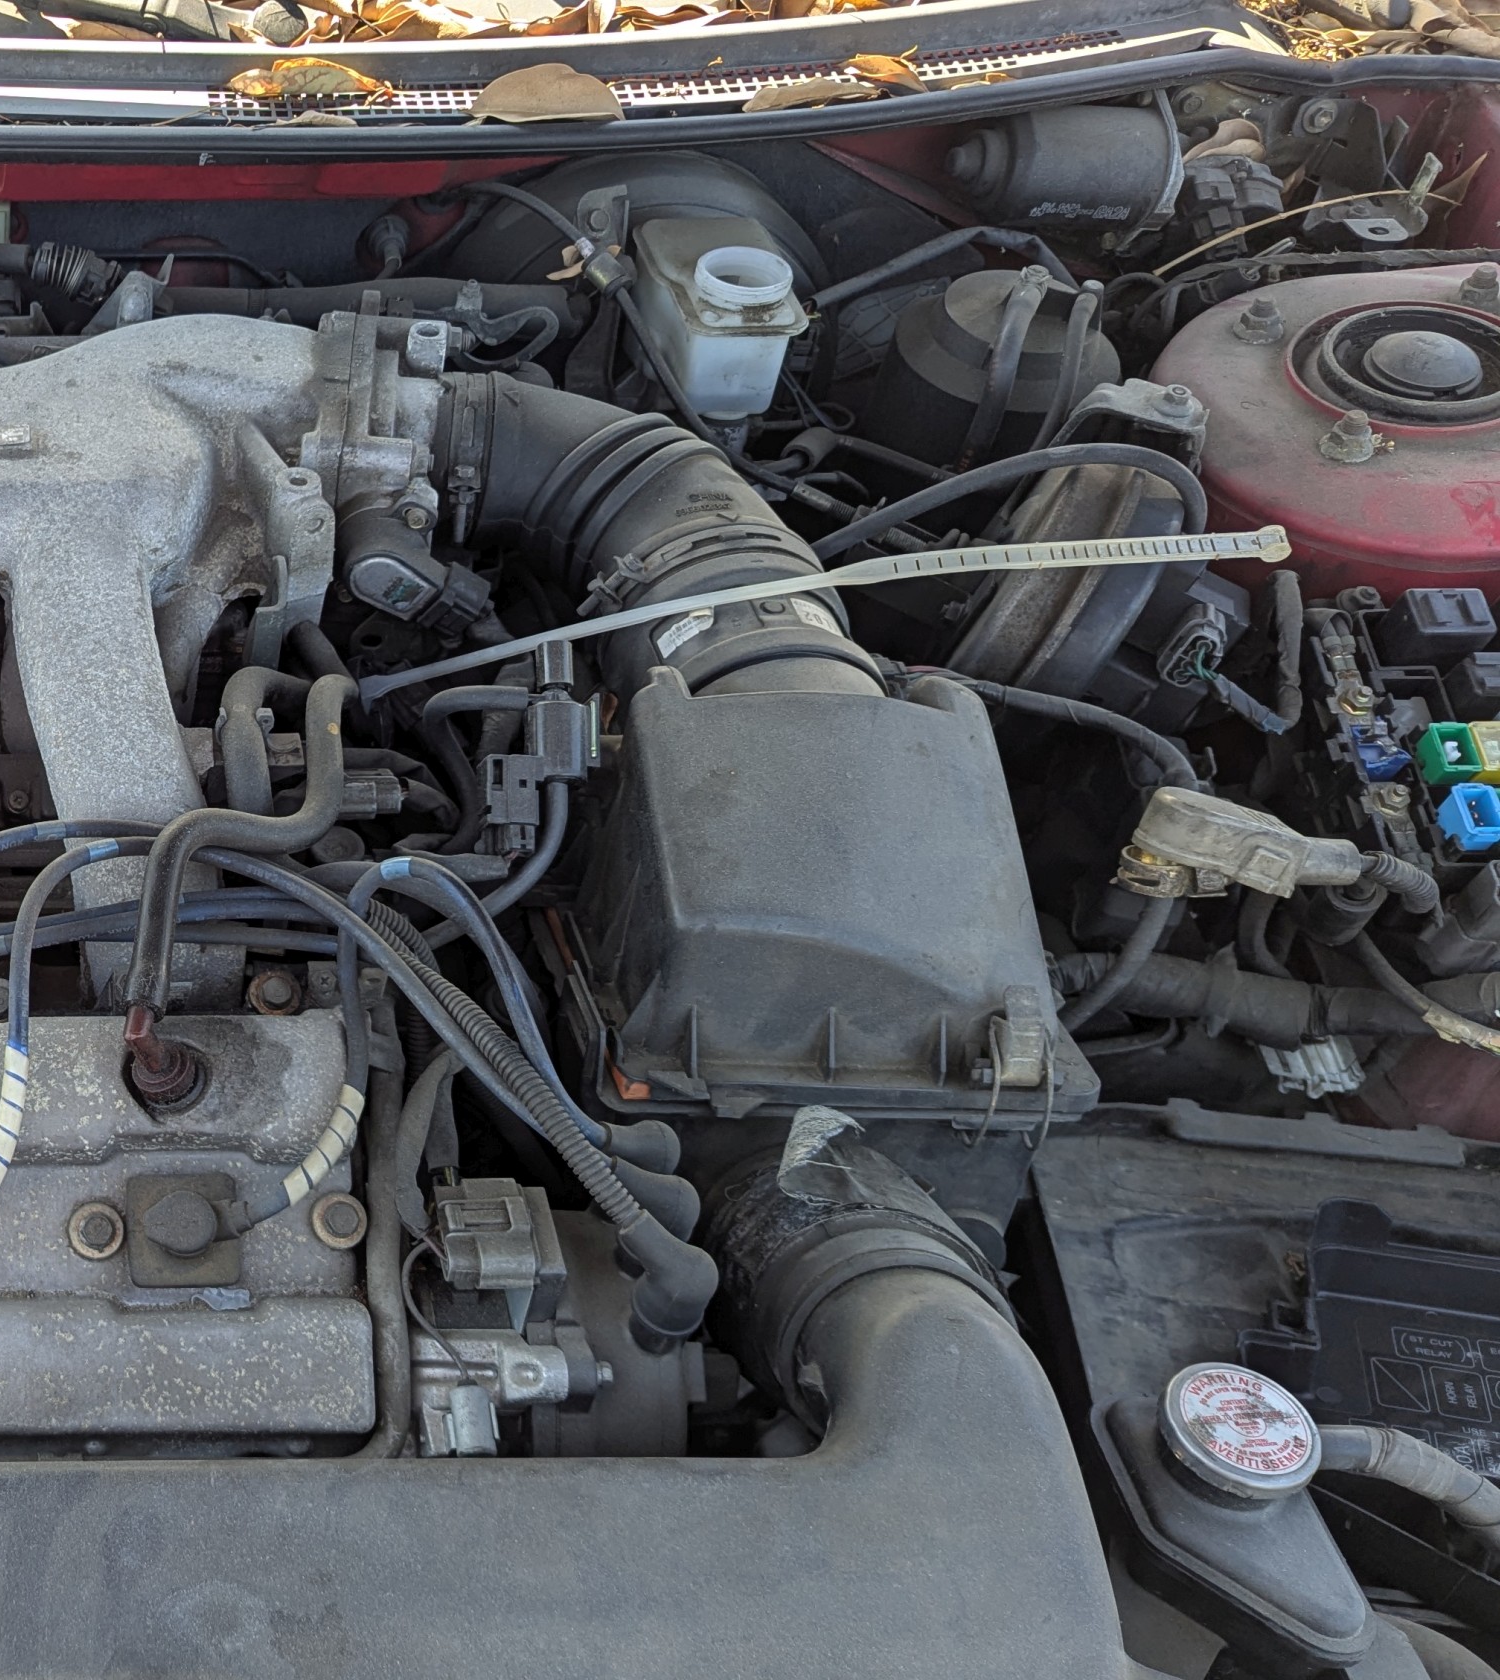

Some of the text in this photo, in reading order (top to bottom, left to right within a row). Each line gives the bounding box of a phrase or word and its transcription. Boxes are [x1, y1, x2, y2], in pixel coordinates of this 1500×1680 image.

[1, 837, 24, 851] NGK
[1429, 1338, 1453, 1347] CUT
[1414, 1347, 1453, 1359] RELAY
[1188, 1373, 1263, 1397] WARNING
[1444, 1381, 1458, 1404] HORN
[1463, 1383, 1478, 1408] RELAY
[1462, 1426, 1487, 1437] USE
[1208, 1434, 1306, 1470] AVERTISSEMENT
